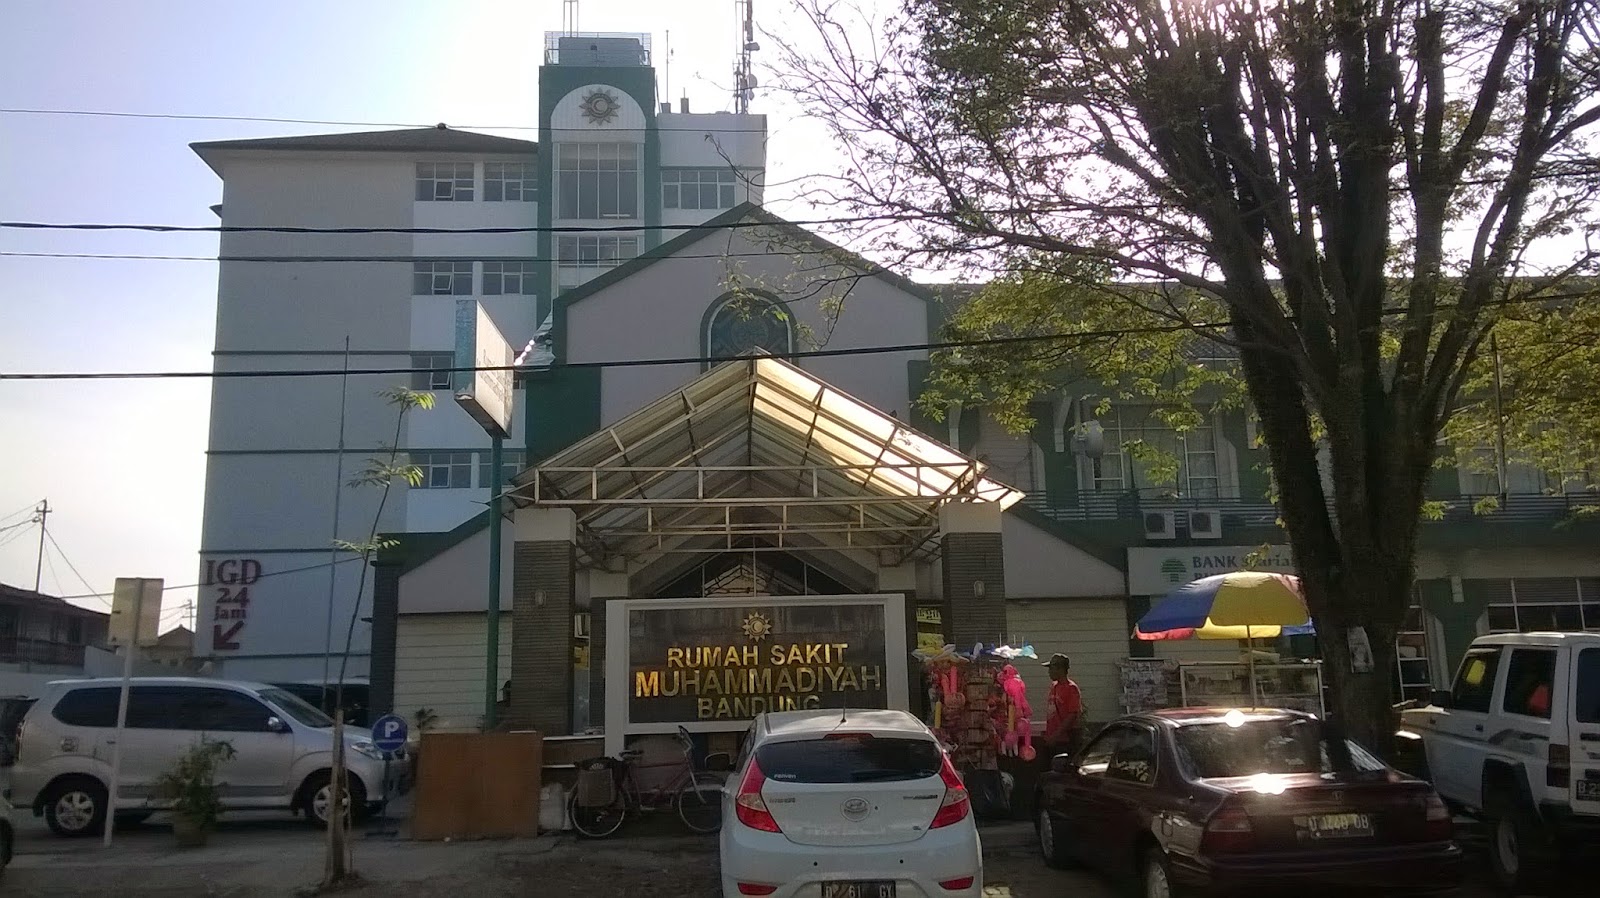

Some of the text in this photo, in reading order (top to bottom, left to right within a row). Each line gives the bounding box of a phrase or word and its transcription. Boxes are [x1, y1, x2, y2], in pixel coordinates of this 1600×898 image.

[206, 559, 262, 585] IGD
[1193, 555, 1238, 568] BANK
[216, 586, 250, 608] 24
[667, 643, 848, 668] RUMAH SAKIT
[635, 665, 881, 698] MUHAMMADIYAH
[385, 721, 399, 738] P
